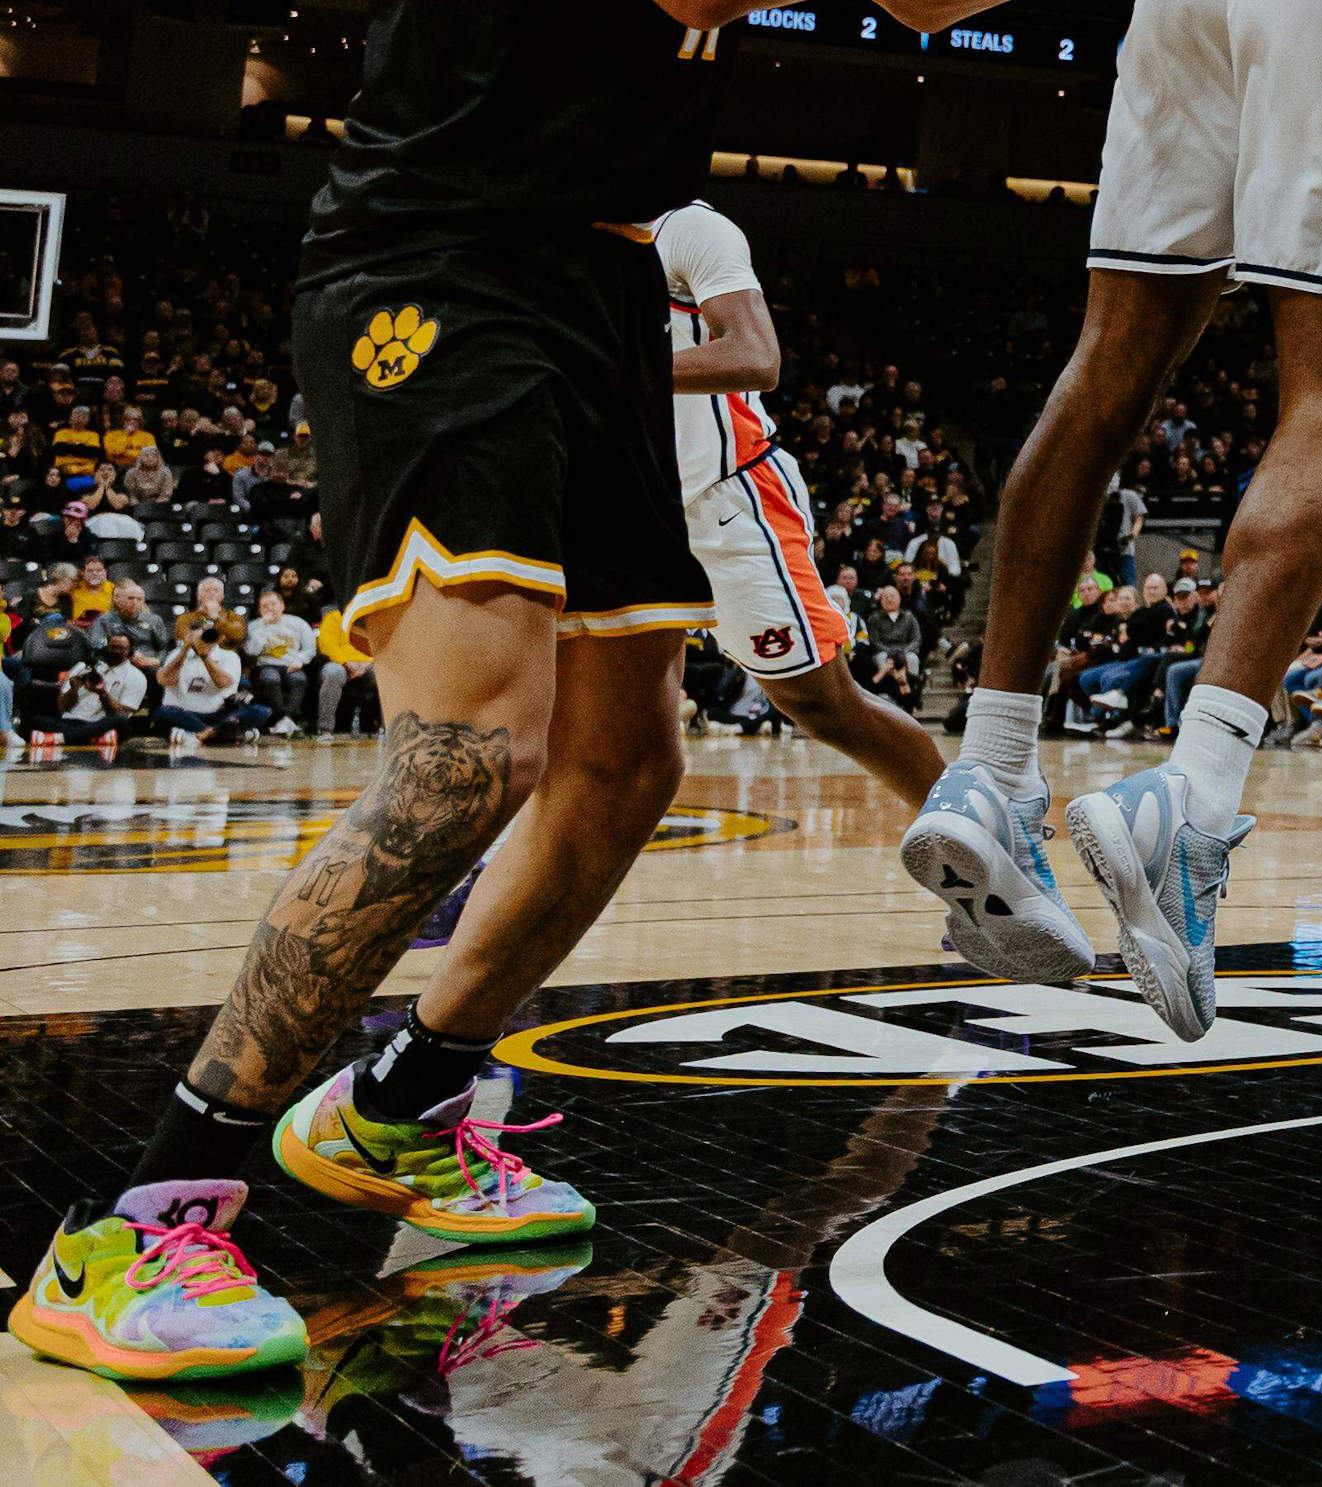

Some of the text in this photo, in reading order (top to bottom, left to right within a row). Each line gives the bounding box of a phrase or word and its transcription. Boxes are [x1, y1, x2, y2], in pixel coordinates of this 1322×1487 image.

[748, 9, 878, 40] BLOCKS 2
[950, 28, 1075, 61] STEALS 2
[377, 355, 405, 382] M
